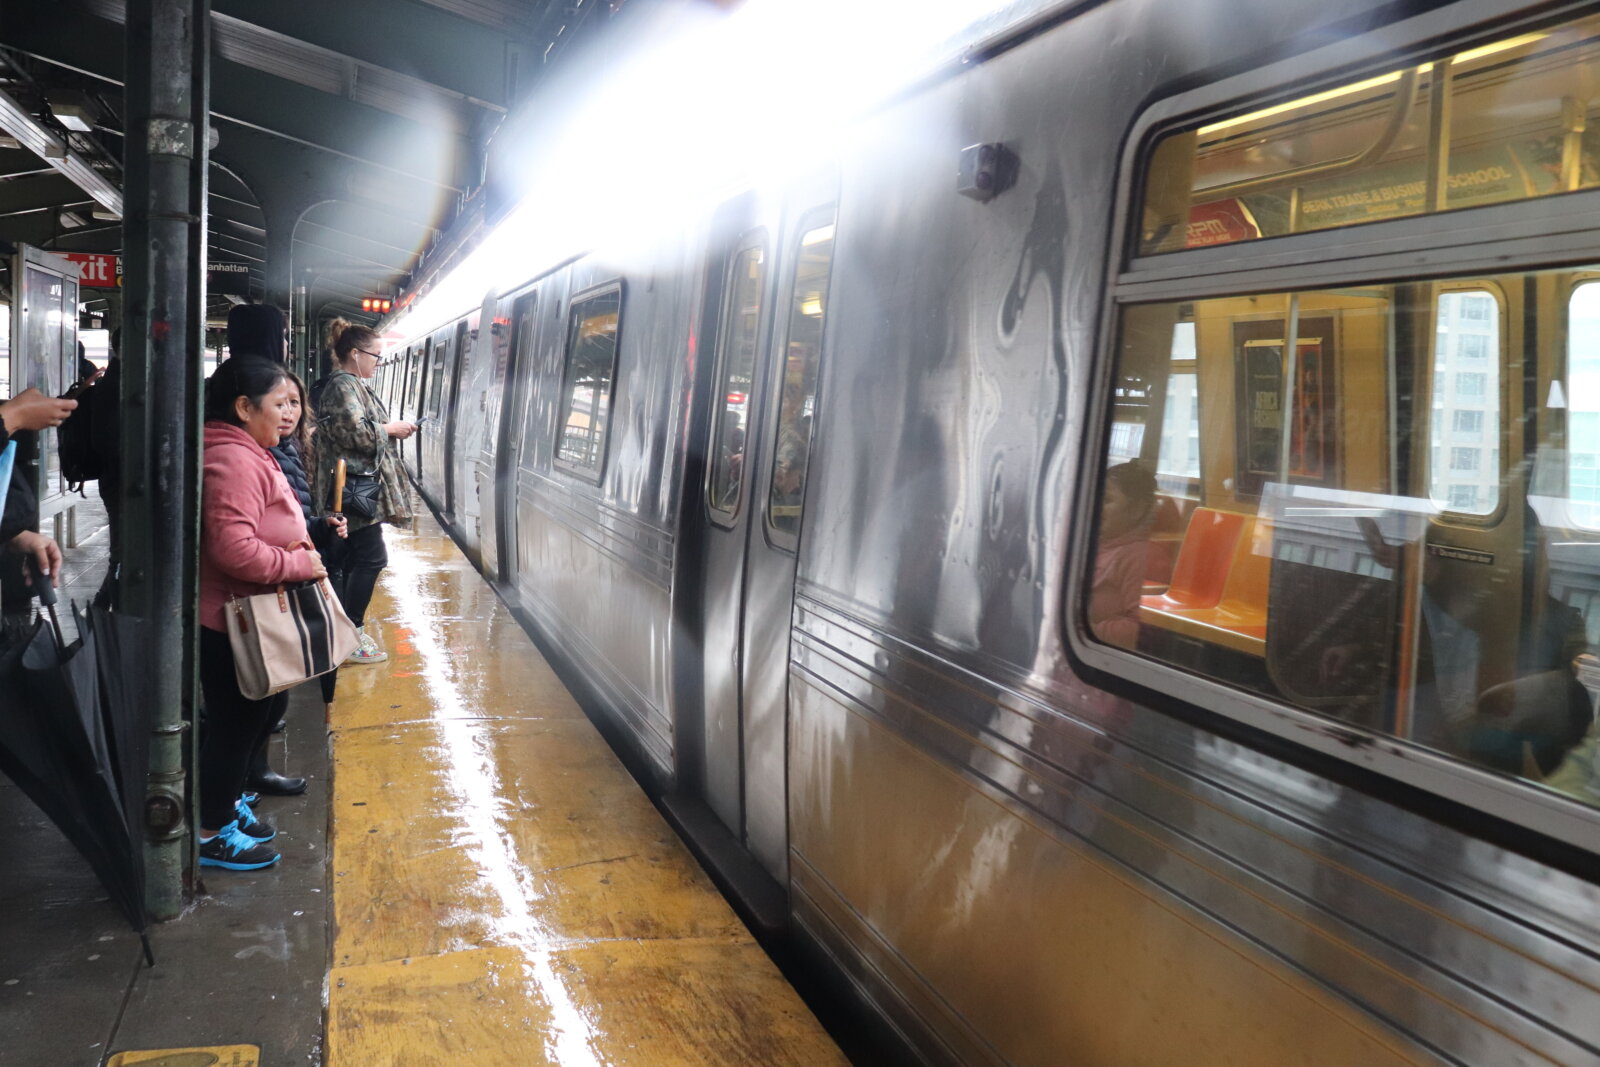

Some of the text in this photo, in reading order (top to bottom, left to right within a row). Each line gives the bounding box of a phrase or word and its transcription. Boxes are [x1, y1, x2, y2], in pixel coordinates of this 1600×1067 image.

[1448, 166, 1513, 189] SCHOOL
[58, 254, 107, 281] xit
[207, 263, 249, 273] anhattan
